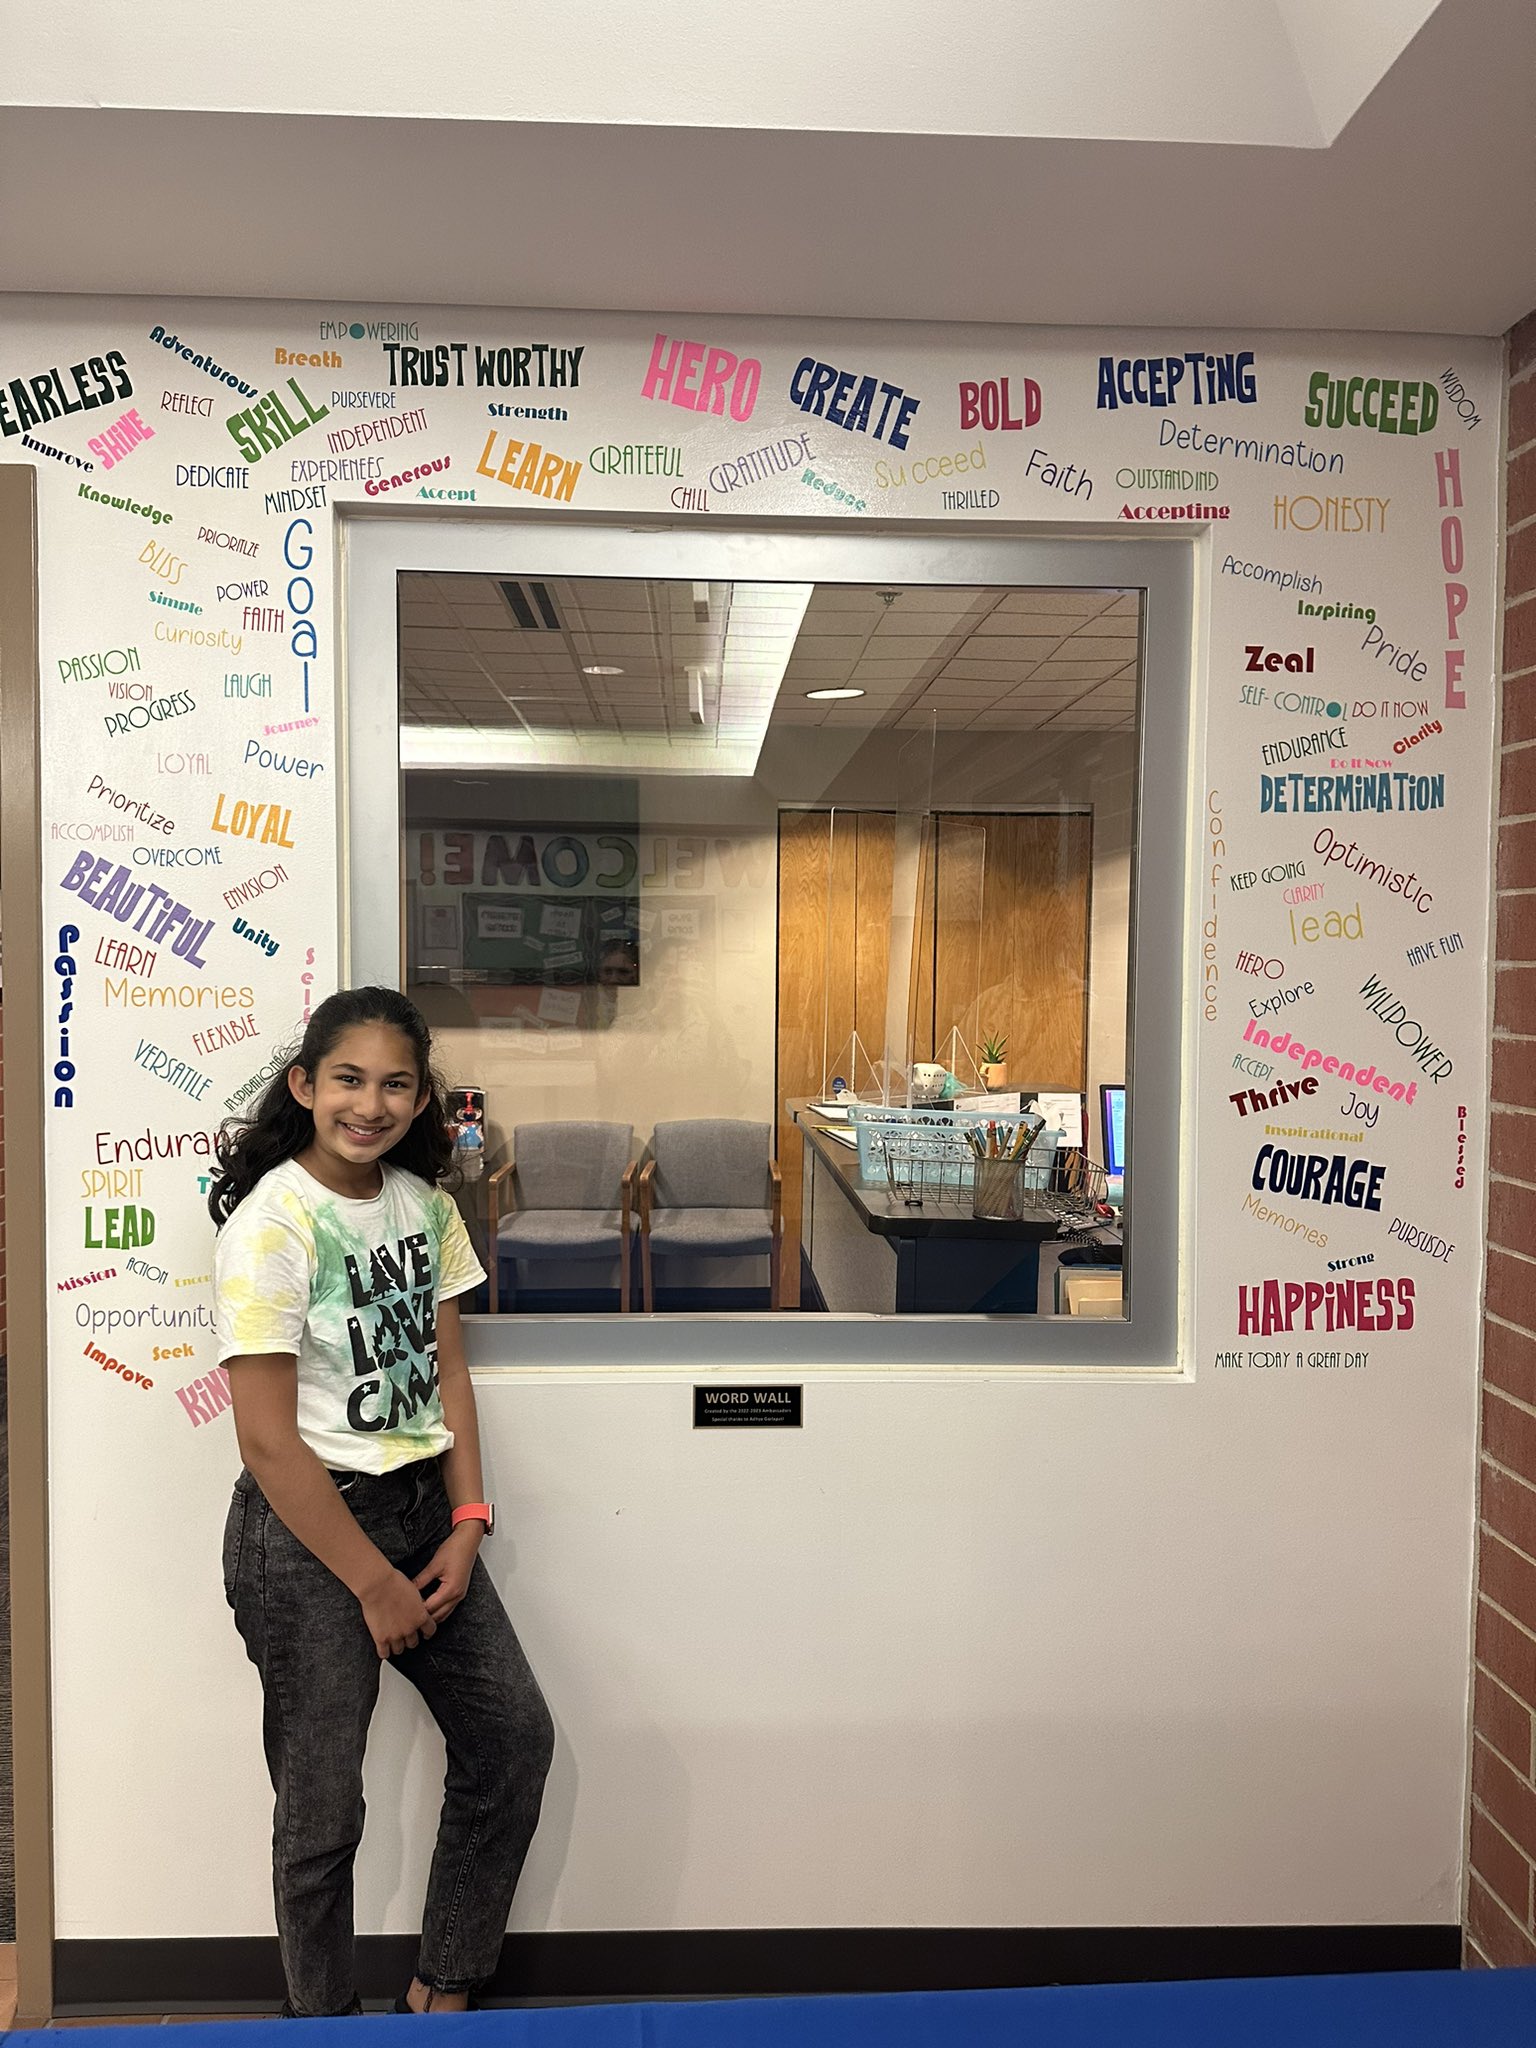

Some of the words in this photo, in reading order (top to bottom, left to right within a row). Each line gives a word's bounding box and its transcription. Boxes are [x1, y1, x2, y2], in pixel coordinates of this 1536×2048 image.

[149, 326, 259, 398] Adventurous
[275, 347, 342, 368] Breath
[383, 343, 468, 388] TRUST
[474, 344, 585, 388] WORTHY
[0, 351, 133, 437] EARLESS
[641, 333, 762, 422] HERO
[160, 391, 215, 417] REFLECT
[332, 391, 396, 409] PURSEVERE
[487, 403, 568, 421] Strength
[790, 357, 920, 451] CREATE
[959, 377, 1042, 431] BOLD
[1304, 371, 1439, 436] SUCCEED
[1439, 367, 1482, 431] WISDOM
[327, 408, 428, 454] INDEPENDENT
[1160, 419, 1344, 474] Determination
[21, 434, 94, 473] Improve
[476, 429, 583, 502] LEARN
[590, 445, 684, 477] GRATEFUL
[709, 432, 816, 494] GRATITUDE
[875, 441, 986, 489] Succeed
[176, 465, 249, 489] DEDICATE
[364, 456, 451, 496] Generous
[416, 486, 478, 501] Accept
[800, 468, 867, 512] Reduce
[1025, 449, 1093, 501] Faith
[77, 483, 173, 525] Knowledge
[264, 485, 327, 514] MINDSET
[671, 487, 710, 512] CHILL
[942, 490, 1000, 510] THRILLED
[1117, 503, 1230, 520] Accepting
[1273, 495, 1391, 533] HONESTY
[138, 539, 188, 585] BLISS
[1221, 554, 1323, 595] Accomplish
[1434, 448, 1468, 709] HOPE
[148, 590, 203, 616] Simple
[216, 580, 269, 602] POWER
[243, 606, 284, 633] FAITH
[1297, 600, 1377, 625] Inspiring
[154, 621, 242, 656] Curiosity
[1361, 625, 1428, 682] Pride
[58, 647, 141, 684] PASSION
[1244, 646, 1315, 673] Zeal
[109, 682, 153, 701] VISION
[224, 673, 272, 698] LAUGH
[104, 689, 196, 737] PROGRESS
[262, 716, 320, 737] Journey
[1352, 701, 1376, 718] DO
[1381, 701, 1390, 718] IT
[1393, 700, 1429, 718] NOW
[1262, 727, 1349, 766] ENDURANCE
[1392, 719, 1443, 755] Clarity
[158, 753, 212, 774] LOYAL
[244, 740, 324, 779] Power
[87, 774, 175, 836] Prioritize
[211, 793, 295, 849] LOYAL
[51, 823, 134, 842] ACCOMPLISH
[133, 846, 223, 867] OVERCOME
[1313, 828, 1433, 914] Optimistic
[222, 863, 289, 910] ENVISION
[1230, 872, 1257, 891] KEEP
[1262, 861, 1306, 883] GOING
[1283, 882, 1325, 905] CLARITY
[1204, 790, 1226, 1021] Confidence
[231, 917, 280, 957] Unity
[1406, 943, 1438, 967] HAVE
[1439, 932, 1464, 955] FUN
[95, 936, 157, 978] LEARN
[1235, 951, 1284, 979] HERO
[105, 976, 255, 1009] Memories
[1248, 981, 1315, 1018] Explore
[54, 924, 80, 1108] Passion
[192, 1013, 260, 1056] FLEXIBLE
[1359, 973, 1453, 1084] WILLPOWER
[133, 1038, 213, 1102] VERSATILE
[1232, 1054, 1275, 1081] ACCEPT
[1242, 1019, 1418, 1105] Independent
[1229, 1077, 1319, 1117] Thrive
[1341, 1092, 1379, 1128] Joy
[95, 1128, 252, 1166] Enduran
[1265, 1124, 1365, 1143] Inspirational
[1455, 1106, 1467, 1189] Blessed
[81, 1169, 144, 1199] SPIRIT
[1251, 1143, 1387, 1212] COURAGE
[84, 1204, 156, 1250] LEAD
[1241, 1193, 1329, 1249] Memories
[57, 1267, 117, 1294] Mission
[126, 1257, 169, 1285] ACTION
[1327, 1253, 1375, 1272] Strong
[83, 1341, 154, 1391] Improve
[152, 1343, 195, 1362] Seek
[1215, 1352, 1243, 1368] MAKE
[1248, 1352, 1290, 1368] TODAY
[1296, 1352, 1303, 1368] A
[1307, 1352, 1340, 1368] GREAT
[1344, 1352, 1369, 1368] DAY
[705, 1392, 749, 1404] WORD
[753, 1392, 792, 1404] WALL
